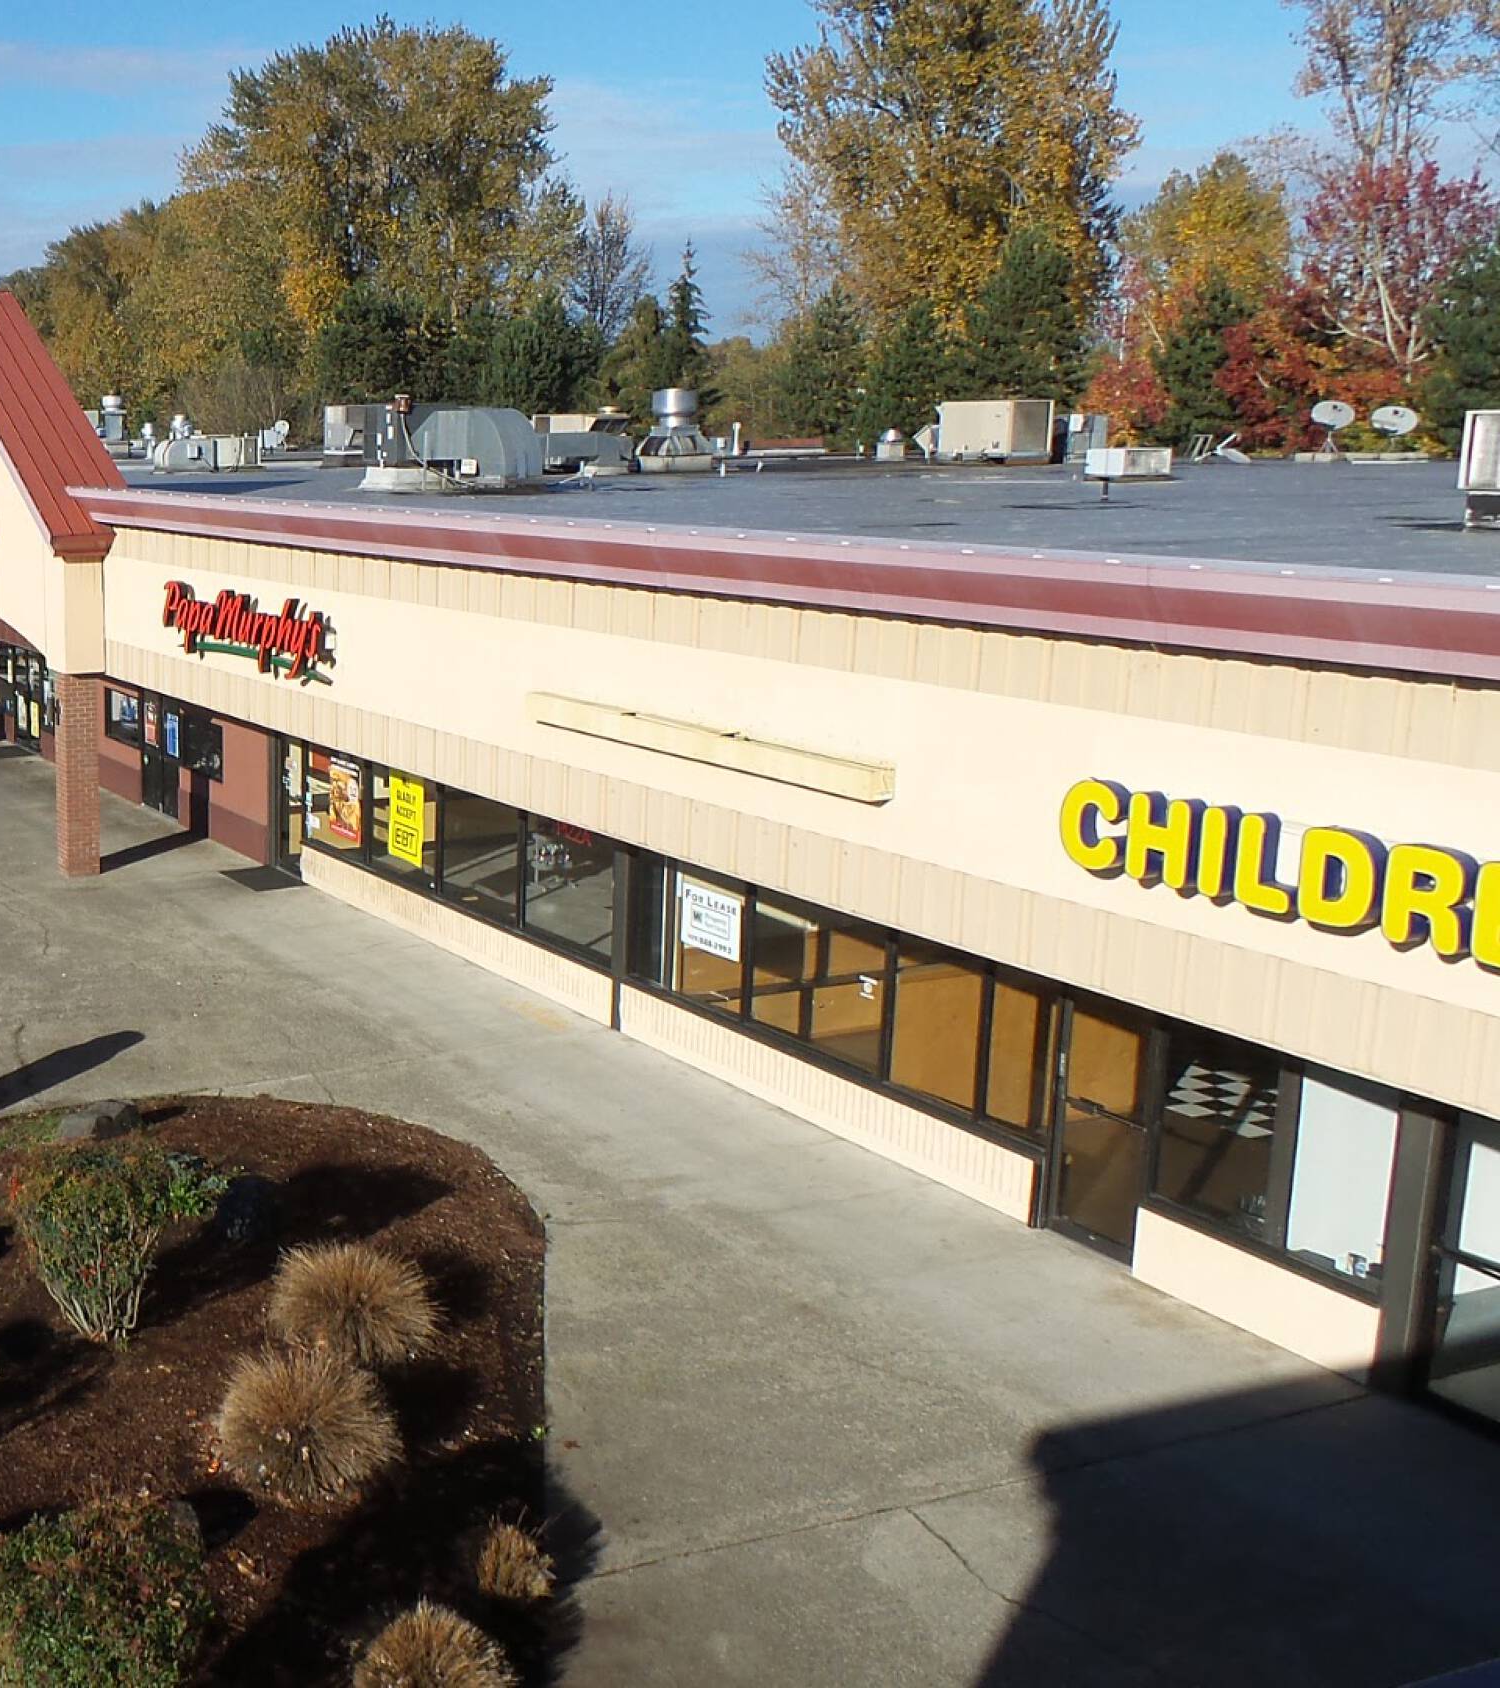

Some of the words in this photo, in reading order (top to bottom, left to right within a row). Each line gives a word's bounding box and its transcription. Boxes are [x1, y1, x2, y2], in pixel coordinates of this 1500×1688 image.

[163, 580, 218, 654] Papa
[214, 588, 324, 680] Murphy's
[394, 827, 416, 849] EBT
